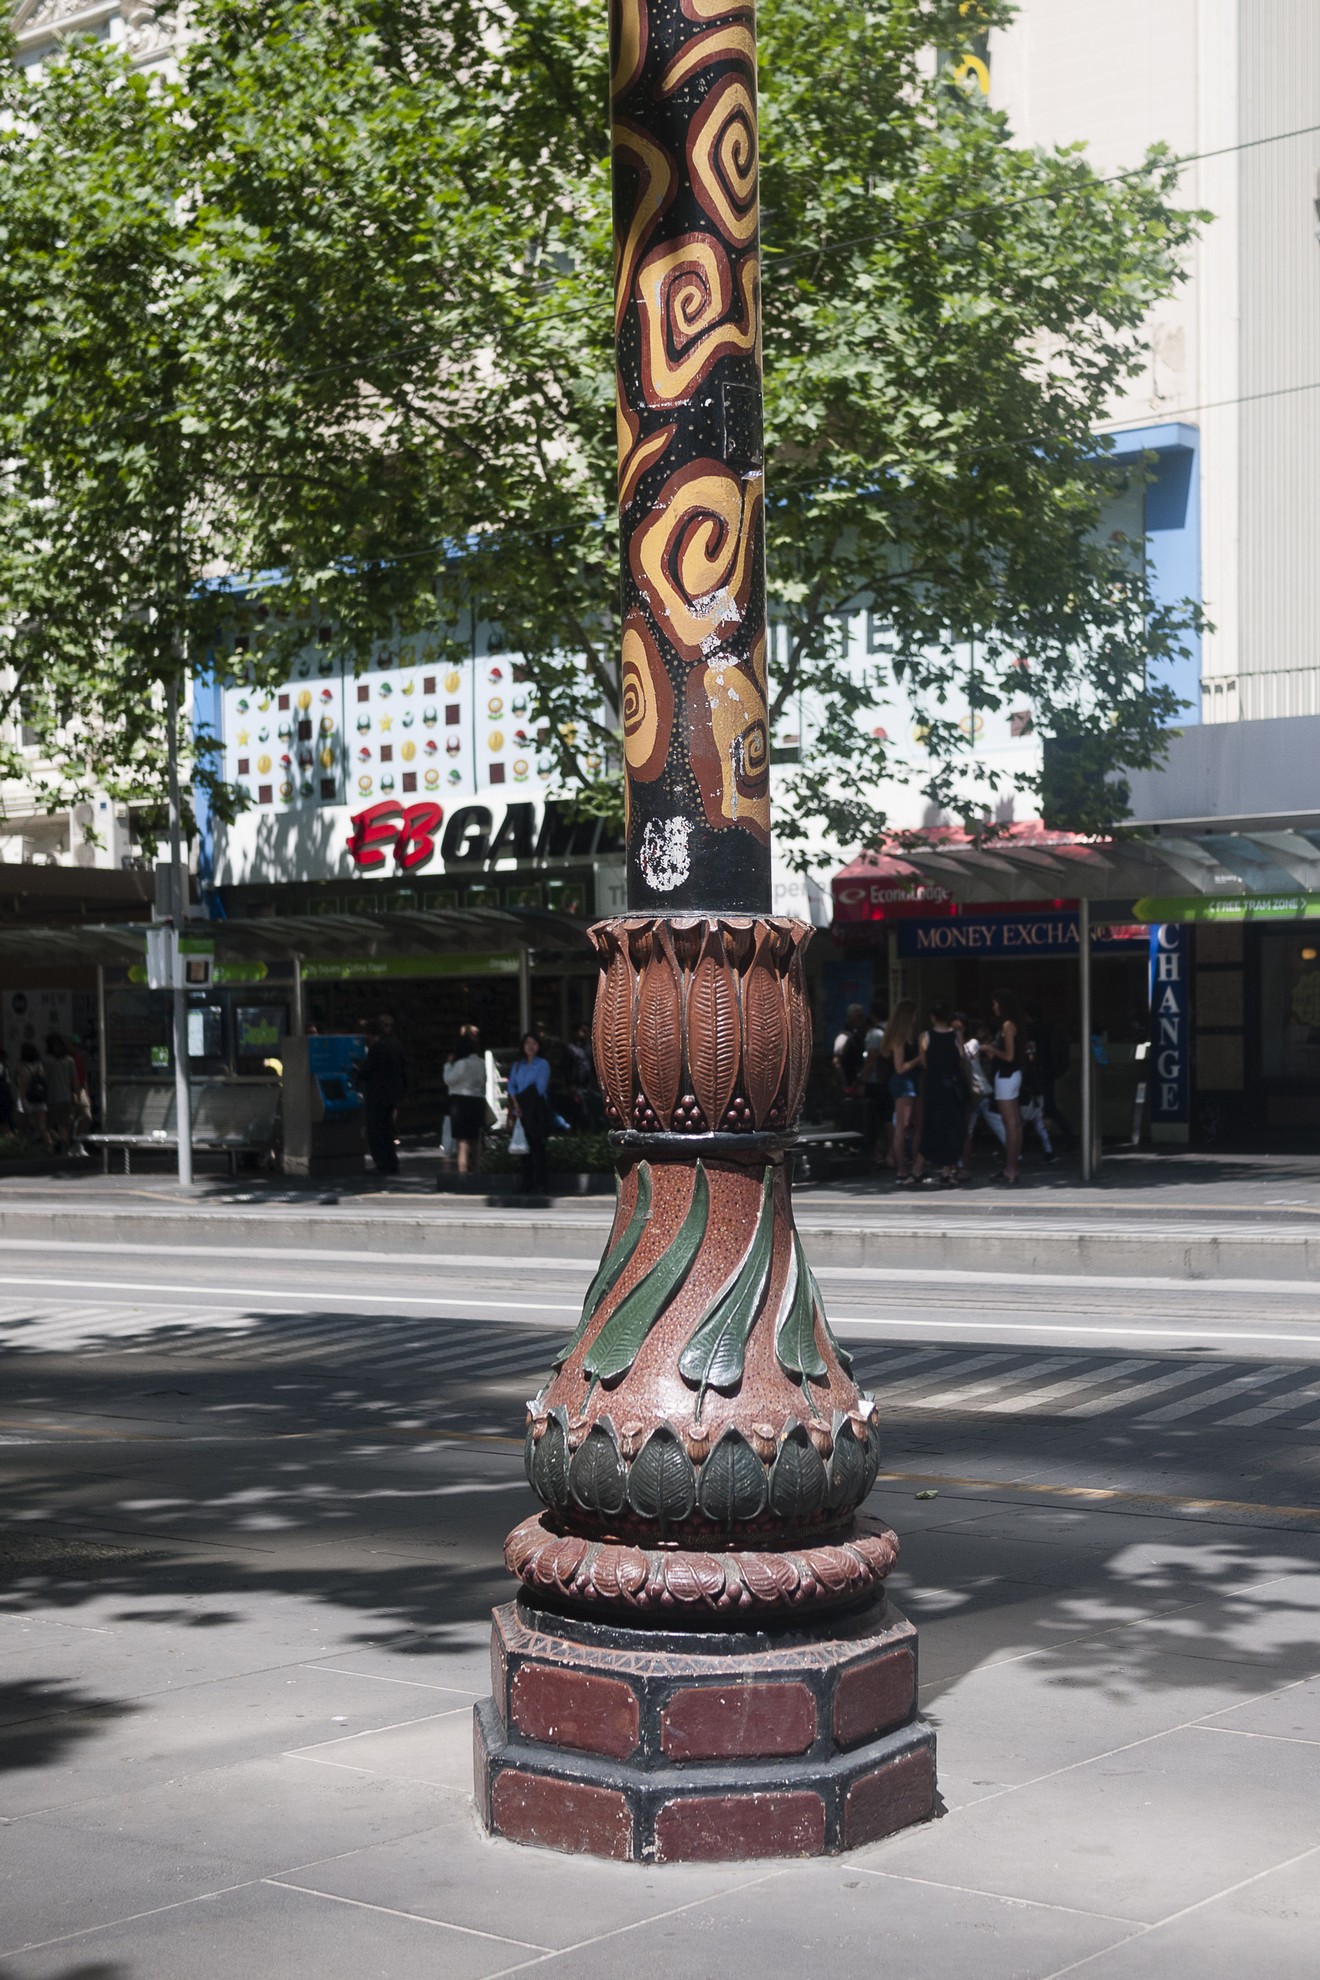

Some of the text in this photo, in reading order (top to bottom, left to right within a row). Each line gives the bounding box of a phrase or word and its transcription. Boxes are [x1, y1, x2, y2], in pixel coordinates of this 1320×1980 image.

[346, 799, 626, 870] EB GAM
[1215, 898, 1298, 912] FREE TRAM ZONE
[917, 925, 996, 949] MONEY
